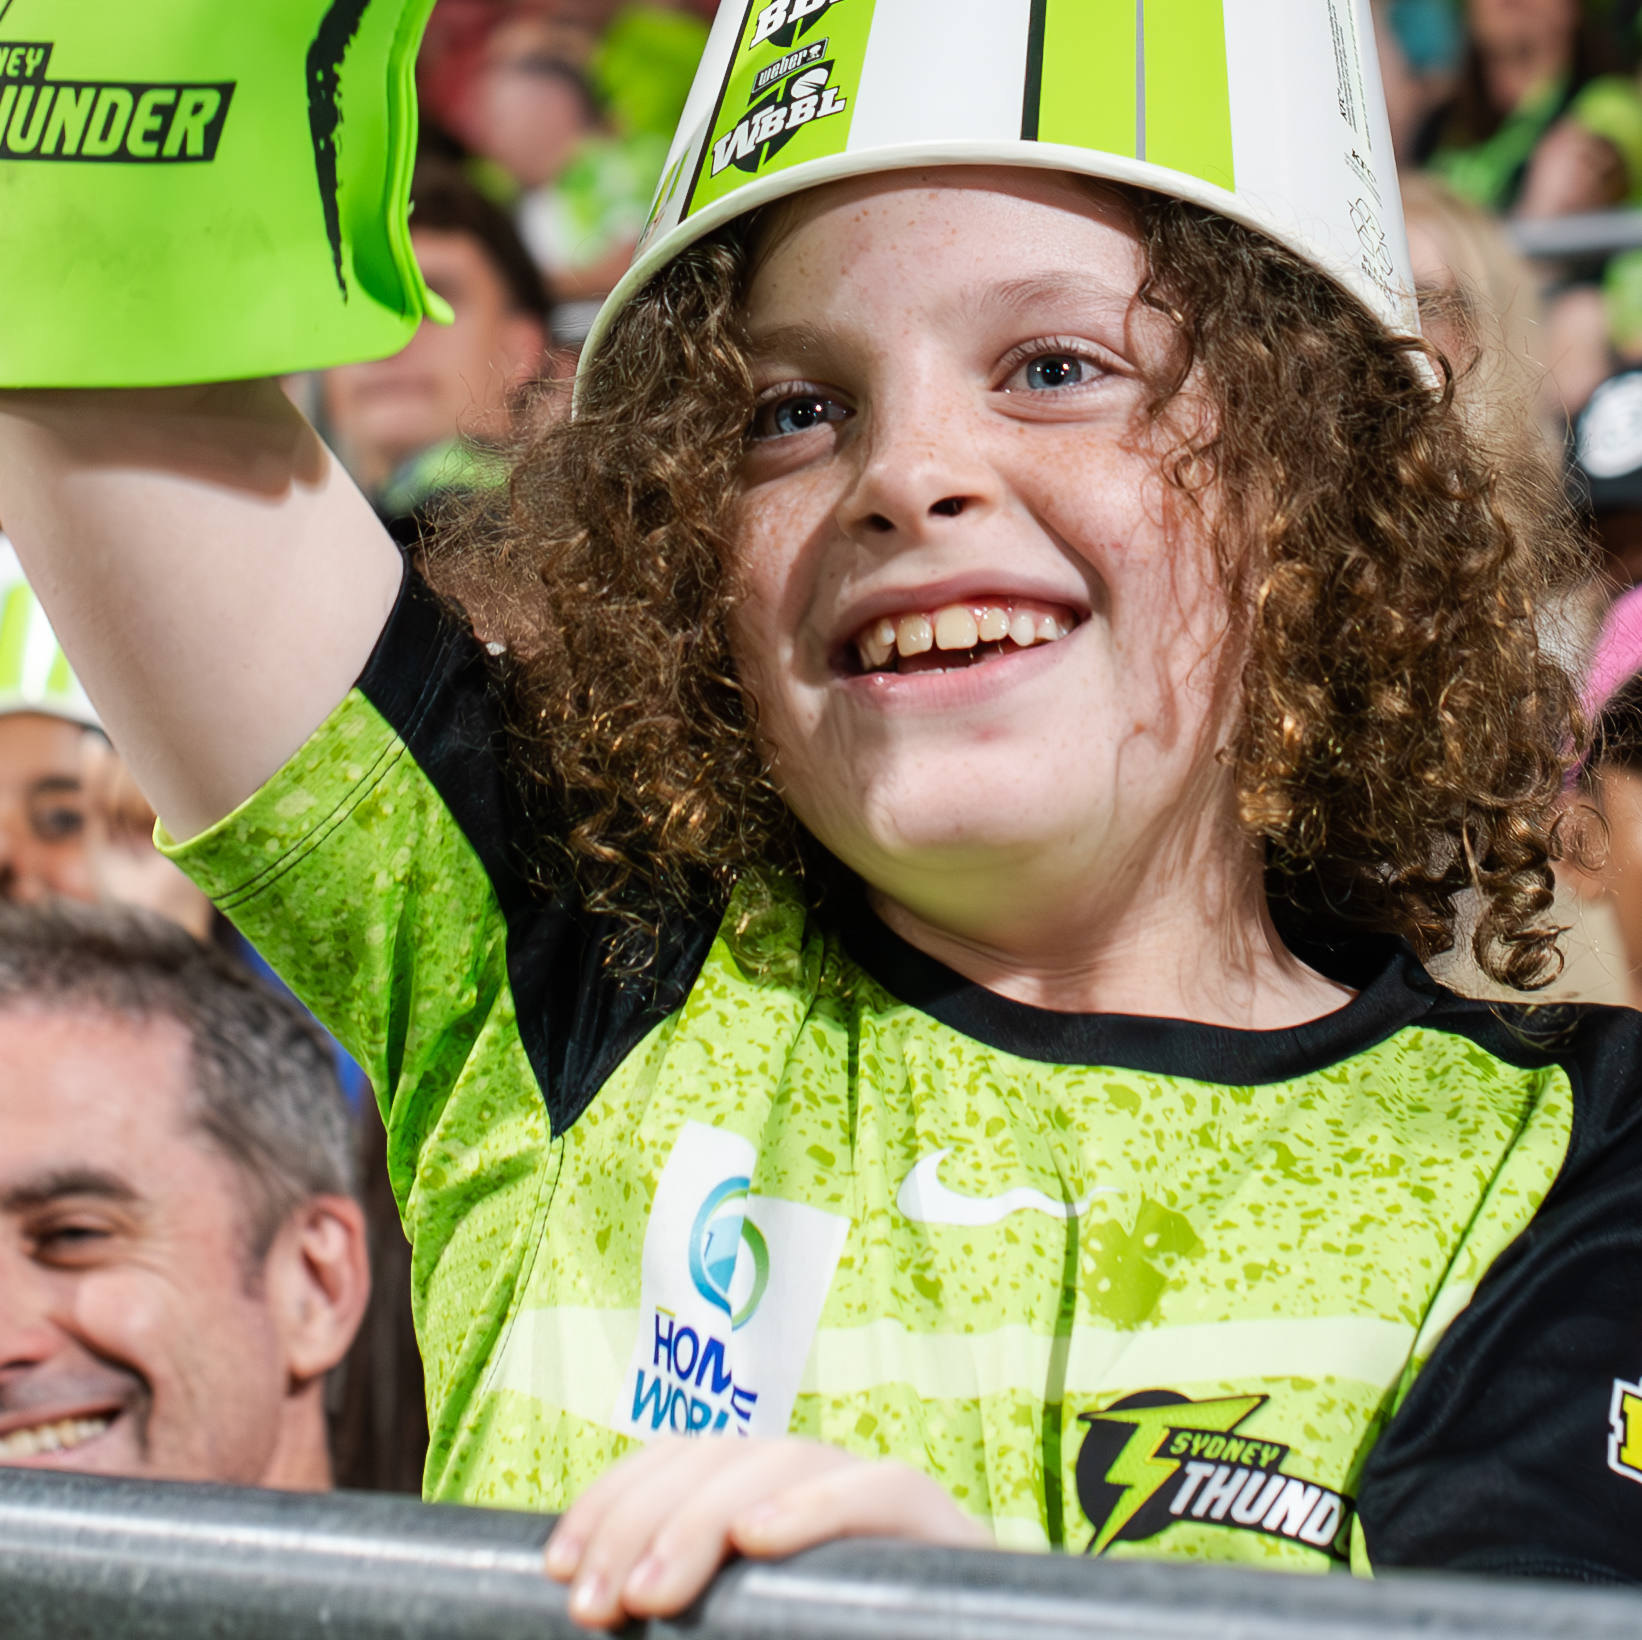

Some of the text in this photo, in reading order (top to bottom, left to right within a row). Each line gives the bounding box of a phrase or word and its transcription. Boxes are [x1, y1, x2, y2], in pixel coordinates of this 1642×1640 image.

[758, 49, 808, 88] weber
[710, 85, 848, 179] WBBL
[1168, 1430, 1281, 1469] SYDNEY
